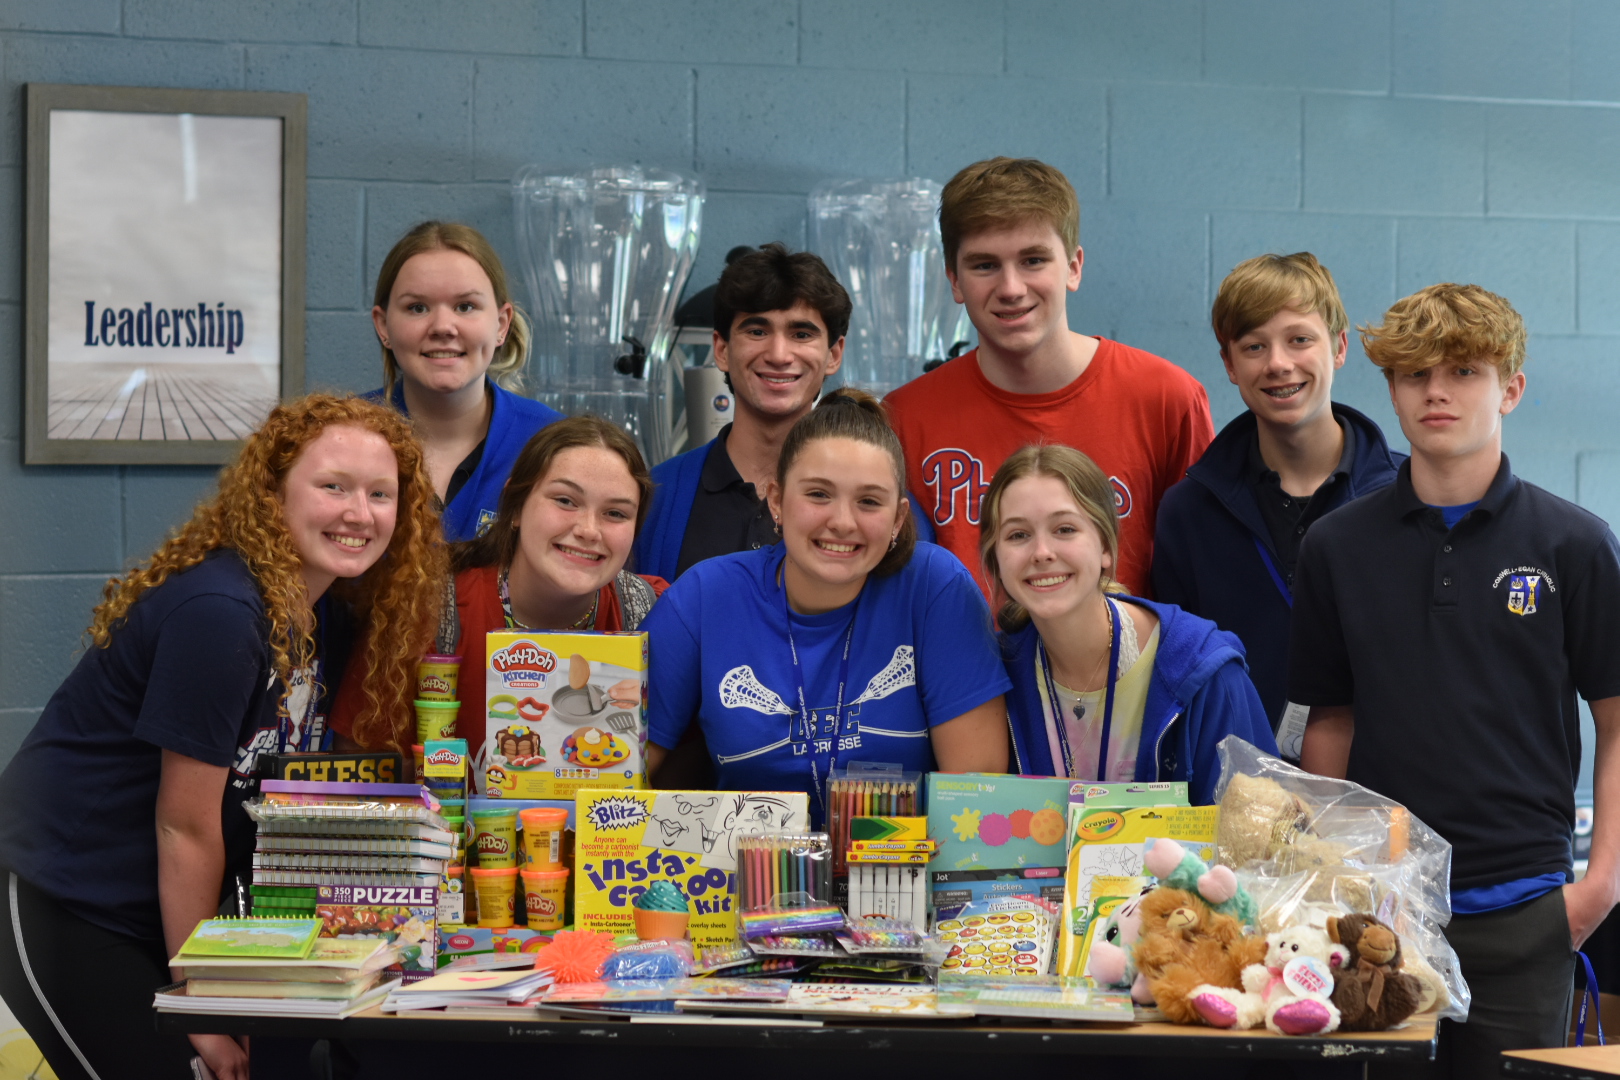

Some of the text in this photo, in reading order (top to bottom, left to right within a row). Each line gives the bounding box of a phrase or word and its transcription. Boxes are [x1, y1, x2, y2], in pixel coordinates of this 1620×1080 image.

[84, 301, 244, 355] Leadership
[493, 648, 554, 671] Play-Doh
[429, 752, 459, 764] Play-Doh
[284, 758, 395, 783] CHESS
[936, 781, 978, 791] SENSORY
[595, 804, 644, 824] Blitz
[1083, 817, 1116, 829] Crayola
[594, 836, 615, 844] Anyone
[611, 843, 640, 851] cartoonist
[585, 850, 610, 858] instantly
[936, 873, 948, 881] Jot
[333, 887, 351, 895] 350
[991, 883, 1023, 891] Stickers
[352, 887, 434, 904] PUZZLE
[694, 895, 731, 915] kit
[1076, 907, 1087, 923] 2
[690, 922, 709, 930] overlay
